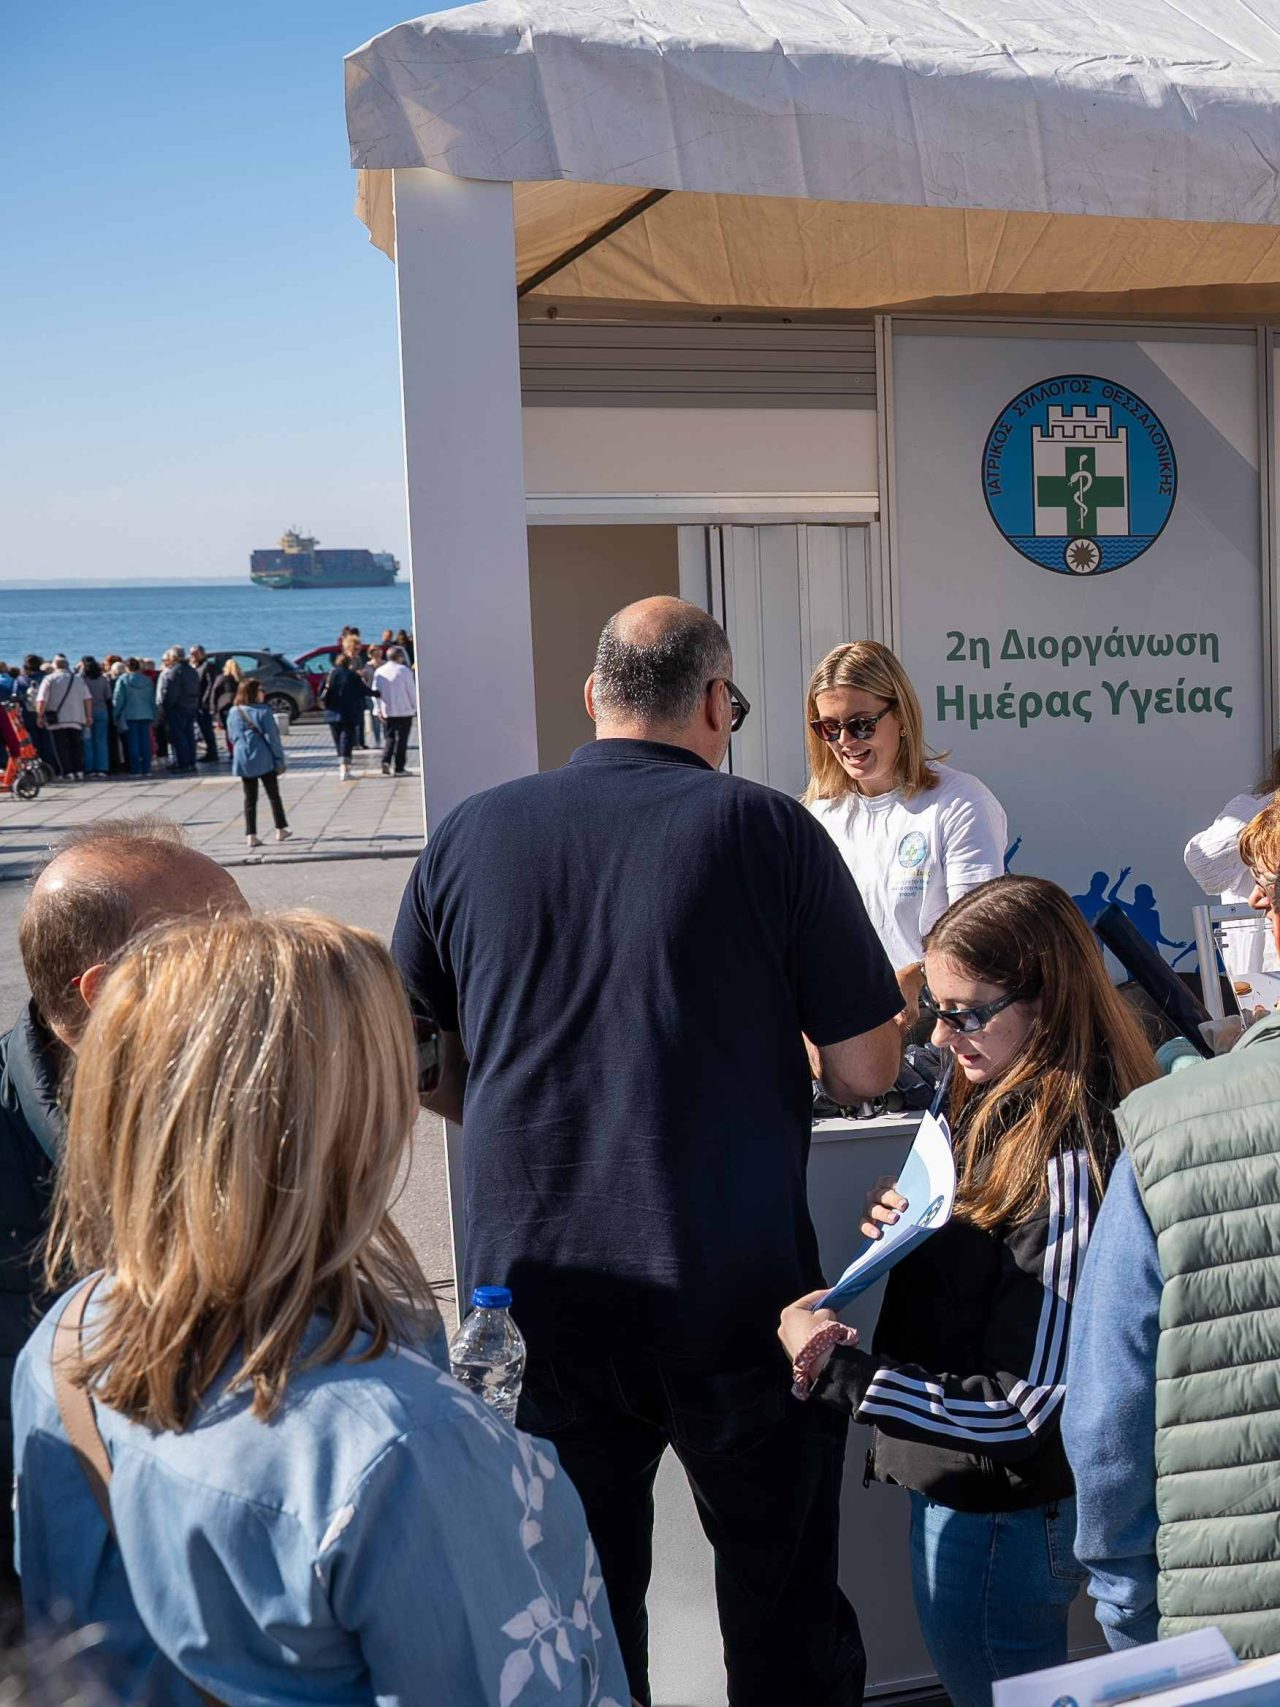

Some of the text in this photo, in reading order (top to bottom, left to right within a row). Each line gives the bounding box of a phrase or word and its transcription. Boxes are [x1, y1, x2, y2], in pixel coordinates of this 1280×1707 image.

[987, 379, 1173, 496] ΙΑΤΡΙΚΟΣ ΣΥΛΛΟΓΟΣ ΘΕΣΣΑΛΟΝΙΚΗΣ
[946, 626, 1220, 669] 2η Διοργάνωση
[936, 677, 1233, 730] Ημέρας Υγείας
